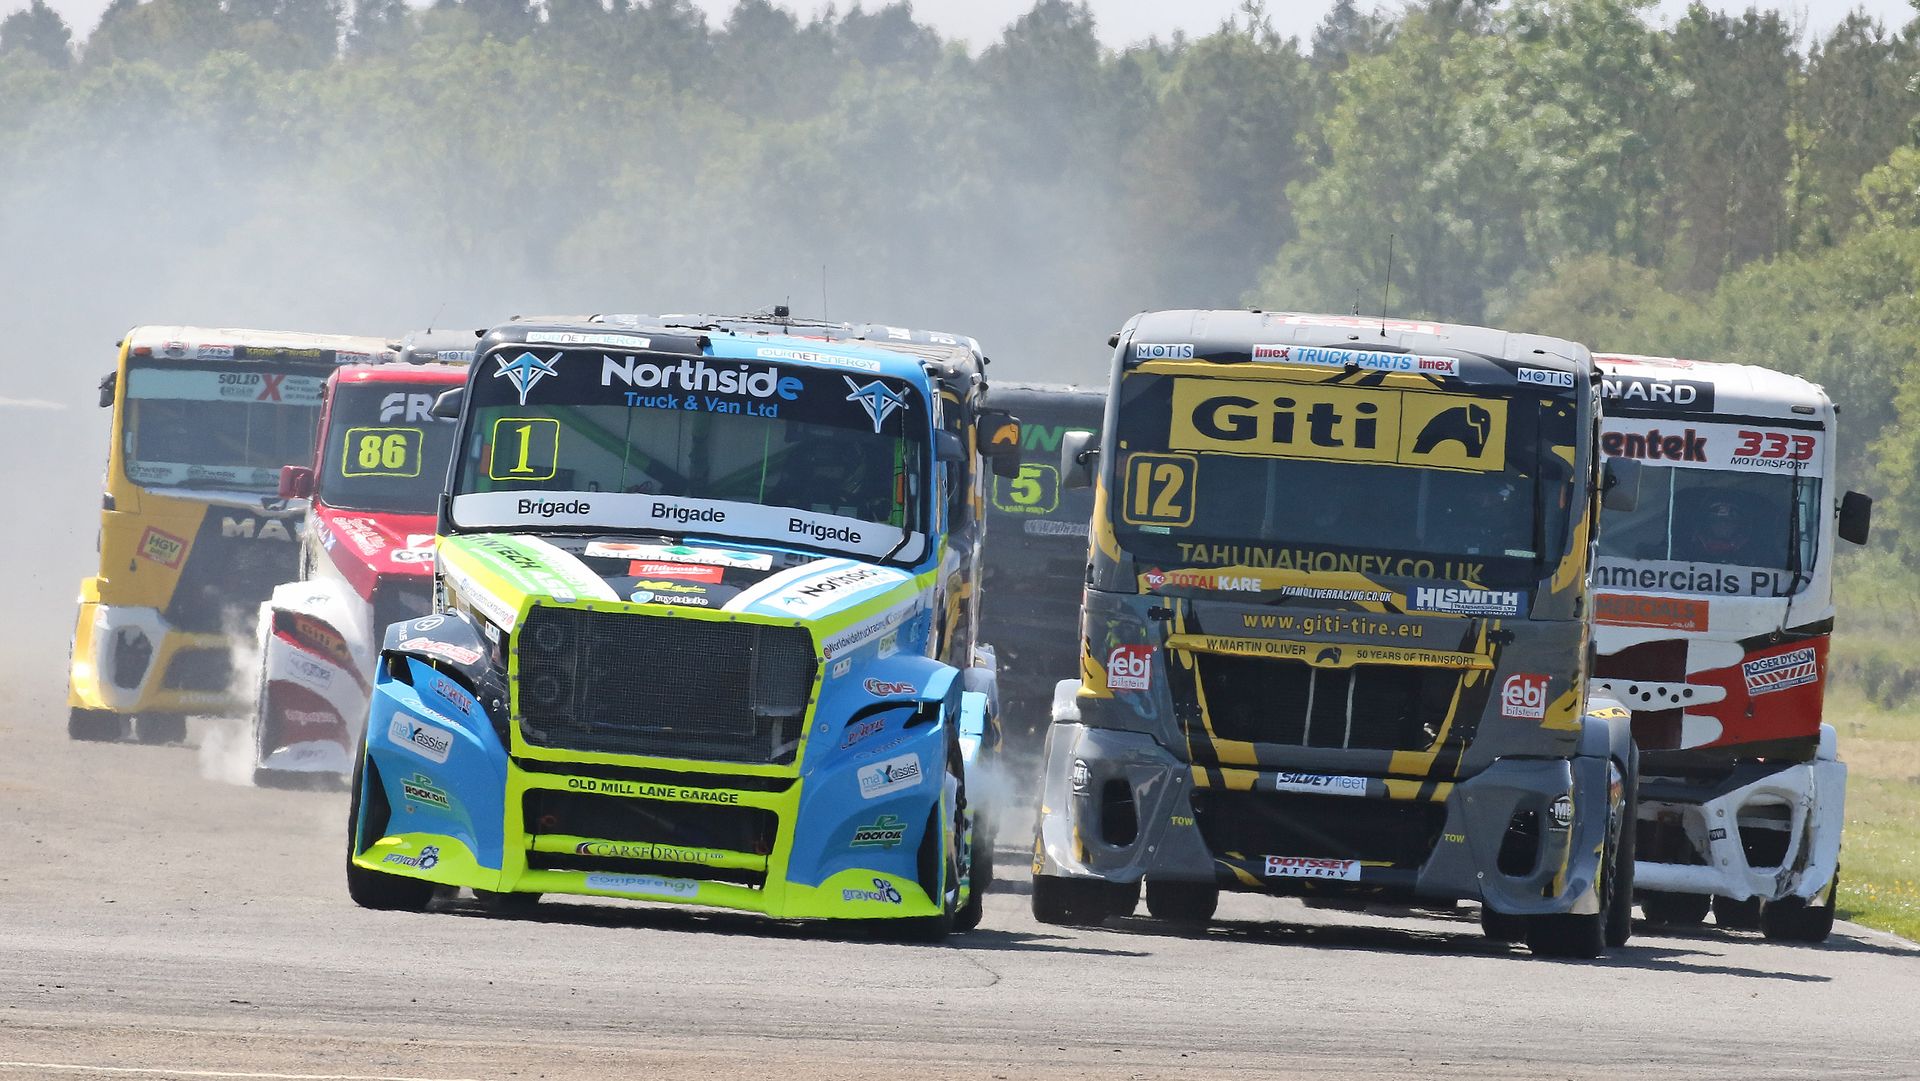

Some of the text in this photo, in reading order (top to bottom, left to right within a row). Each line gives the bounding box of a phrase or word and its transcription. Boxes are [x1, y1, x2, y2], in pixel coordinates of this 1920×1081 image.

[1138, 345, 1192, 358] MOTIS
[1254, 346, 1454, 373] imex TRUCK PARTS imex
[218, 373, 260, 386] SOLID
[601, 355, 804, 401] Northside
[1519, 368, 1573, 386] MOTIS
[1602, 380, 1697, 405] NARD
[380, 392, 457, 423] FR
[624, 391, 777, 418] Truck & Van Ltd
[1191, 396, 1379, 450] Giti
[359, 434, 407, 469] 86
[508, 424, 534, 473] 1
[1602, 429, 1708, 462] entek
[1734, 430, 1816, 461] 333
[1730, 456, 1810, 471] MOTORSPORT
[1010, 467, 1042, 505] 5
[1134, 462, 1184, 518] 12
[517, 498, 591, 517] Brigade
[651, 503, 726, 523] Brigade
[788, 518, 862, 544] Brigade
[149, 535, 180, 552] HGV
[1177, 542, 1485, 582] TAHUNAHONEY.CO.UK
[1281, 586, 1392, 602] TEAMOLIVERRACING.CO.UK
[1243, 613, 1423, 638] www.giti-tire.eu
[1207, 638, 1306, 655] W.MARTIN OLIVER
[1107, 647, 1152, 678] febi
[1357, 650, 1476, 666] 50 YEARS OF TRANSPORT
[1744, 648, 1814, 677] ROGER DYSON
[1502, 674, 1548, 708] febi
[1506, 706, 1540, 717] bilstein
[405, 785, 448, 804] ROCK OIL
[568, 778, 739, 804] OLD MILL LANE GARAGE
[1171, 816, 1193, 826] TOW
[854, 831, 902, 840] ROCK OIL
[1444, 833, 1465, 843] TOW
[597, 843, 708, 863] CARSFORYOU
[1268, 856, 1355, 870] ODYSSEY
[589, 874, 697, 892] comparehgv
[1268, 866, 1348, 878] BATTERY
